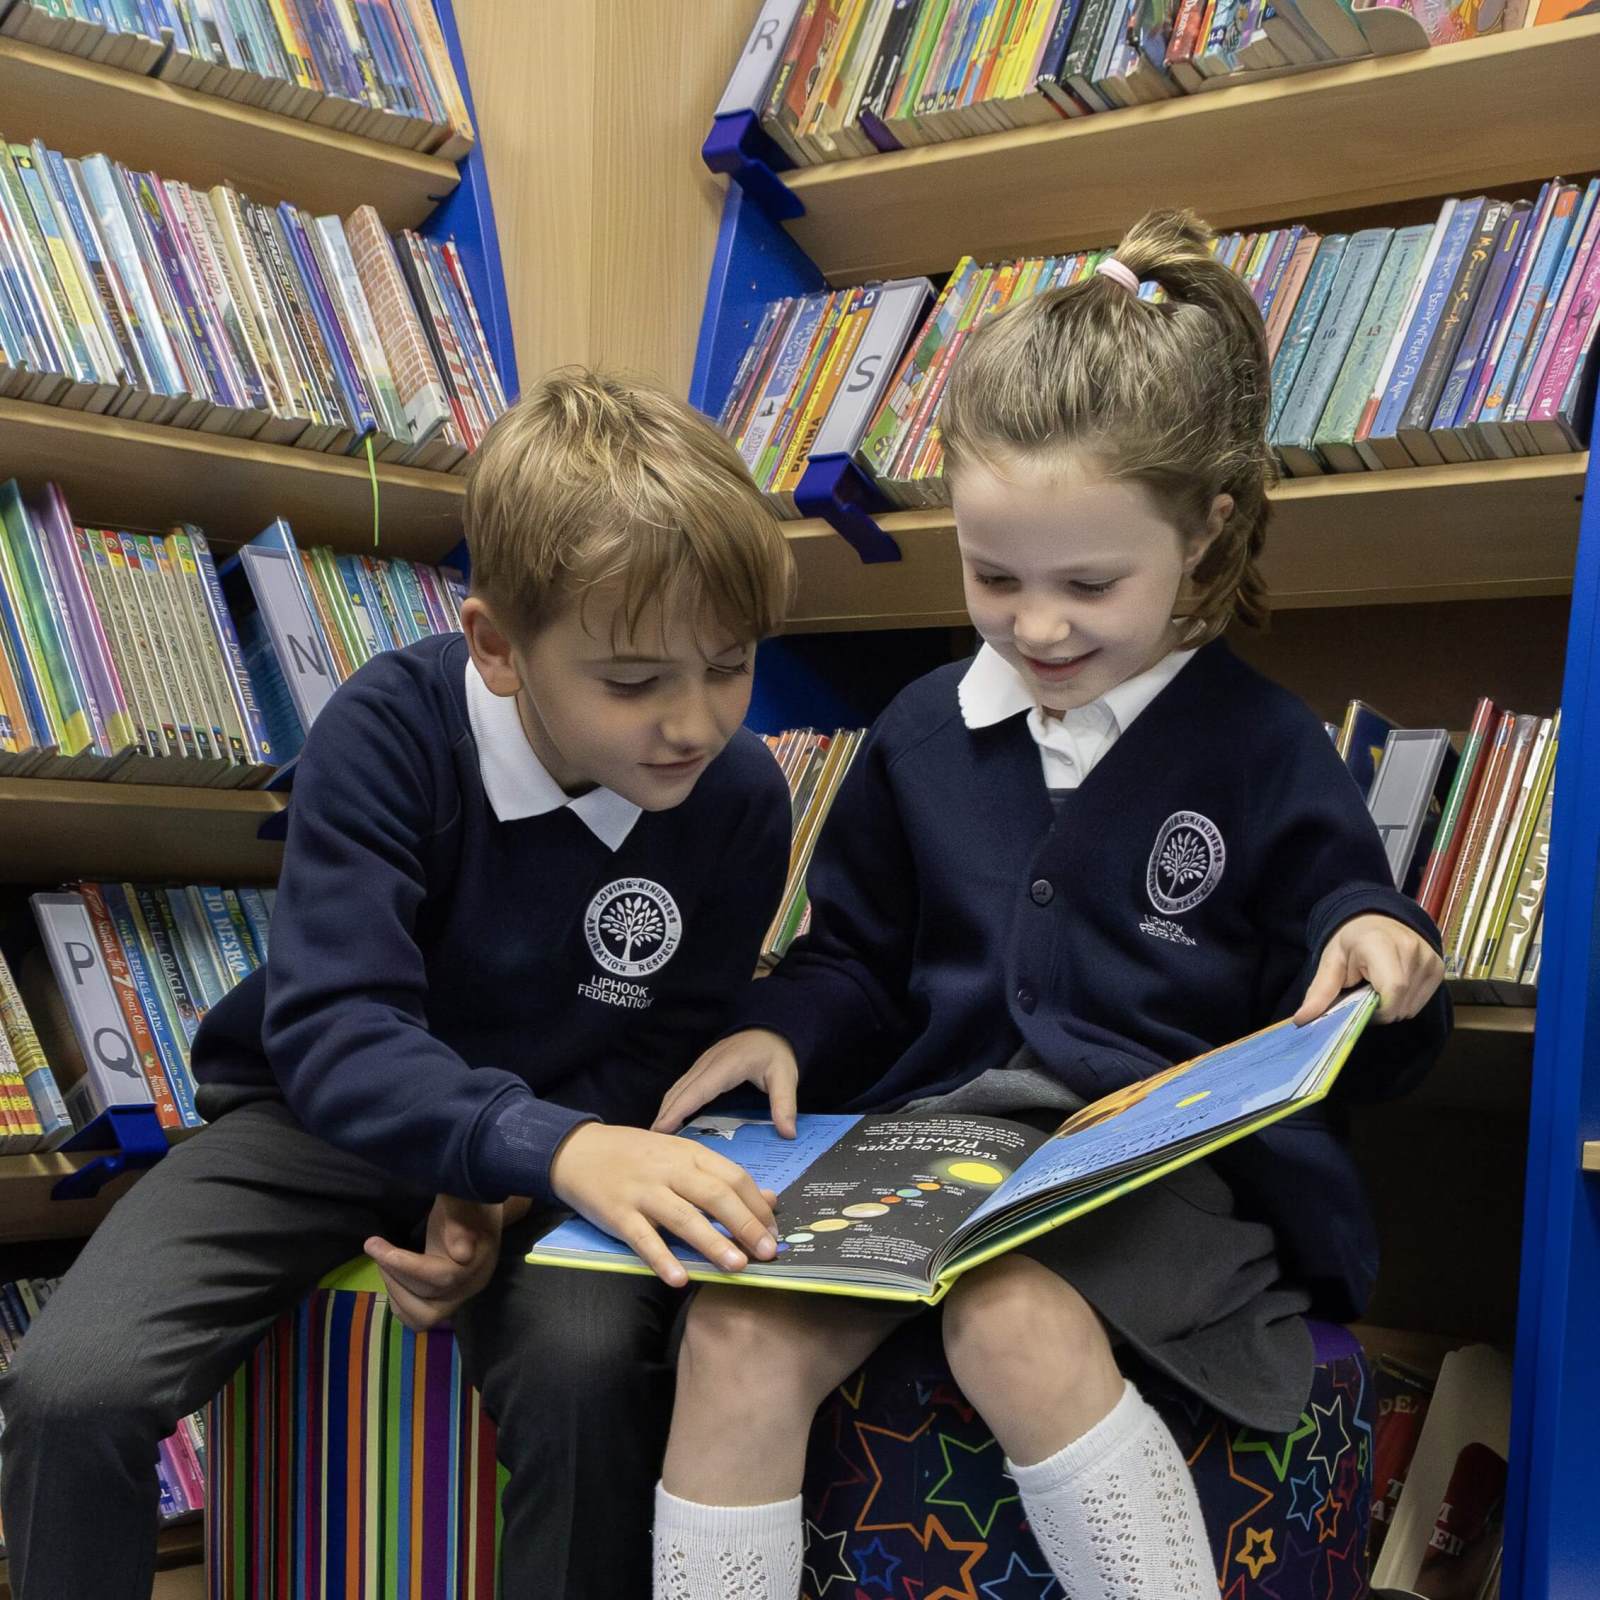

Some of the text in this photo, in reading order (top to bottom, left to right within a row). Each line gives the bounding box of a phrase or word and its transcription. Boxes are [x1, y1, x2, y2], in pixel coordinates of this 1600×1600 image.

[749, 20, 780, 54] R
[846, 355, 882, 392] S
[288, 634, 326, 676] N
[64, 942, 95, 984] P
[638, 937, 677, 972] RESPECT
[591, 975, 649, 998] LIPHOOK
[94, 1028, 142, 1078] Q
[858, 1144, 906, 1152] OTHER
[888, 1136, 980, 1149] PLANETS
[937, 1146, 998, 1160] SEASONS
